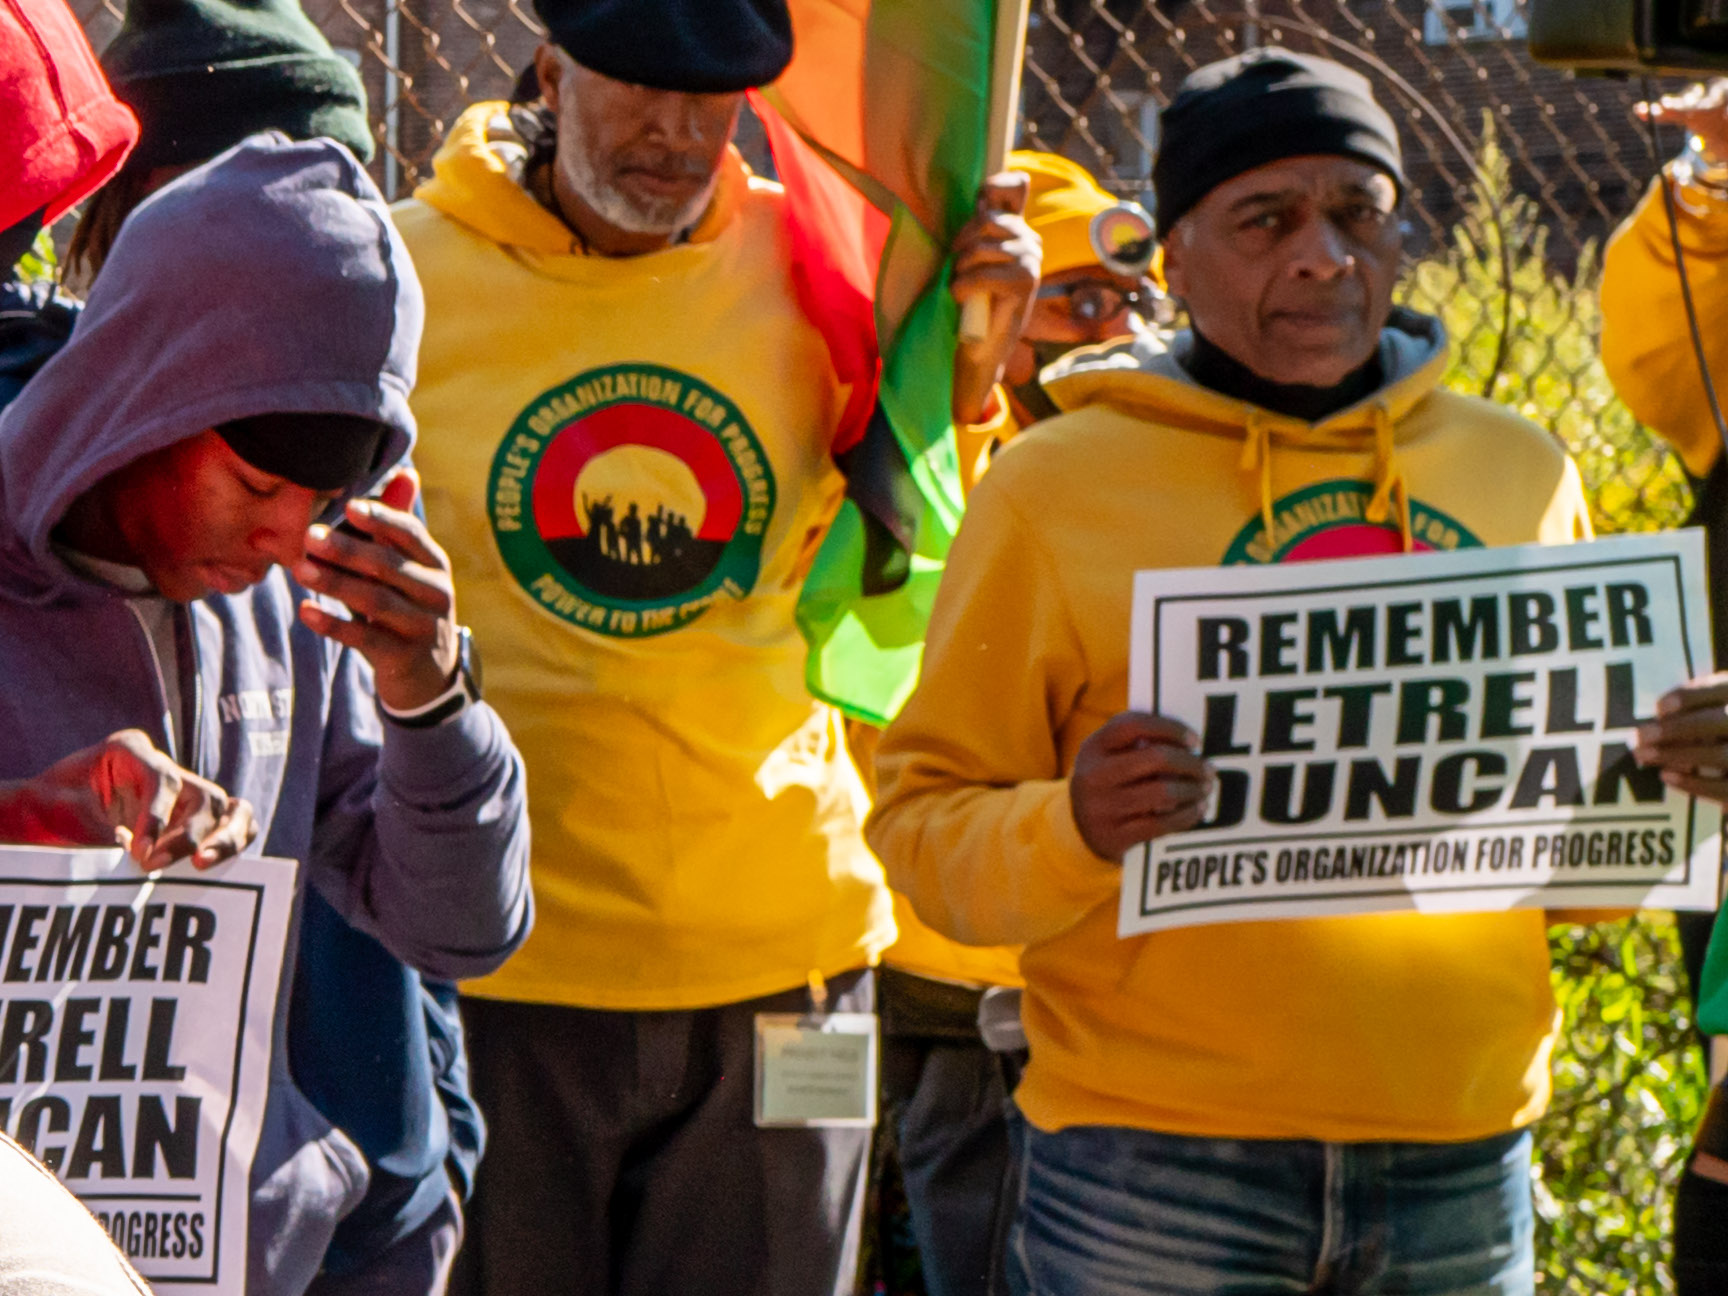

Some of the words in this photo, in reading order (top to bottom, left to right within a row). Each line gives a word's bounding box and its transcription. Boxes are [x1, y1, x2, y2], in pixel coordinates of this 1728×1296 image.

[527, 373, 683, 437] ORGANIZATION
[683, 389, 727, 428] FOR
[1196, 580, 1654, 682] REMEMBER
[1202, 661, 1661, 758] LETRELL
[1155, 852, 1267, 896] PEOPLE'S
[1275, 837, 1469, 886] ORGANIZATION
[1475, 832, 1524, 873] FOR
[1532, 828, 1675, 869] PROGRESS
[92, 1211, 205, 1259] OGRESS
